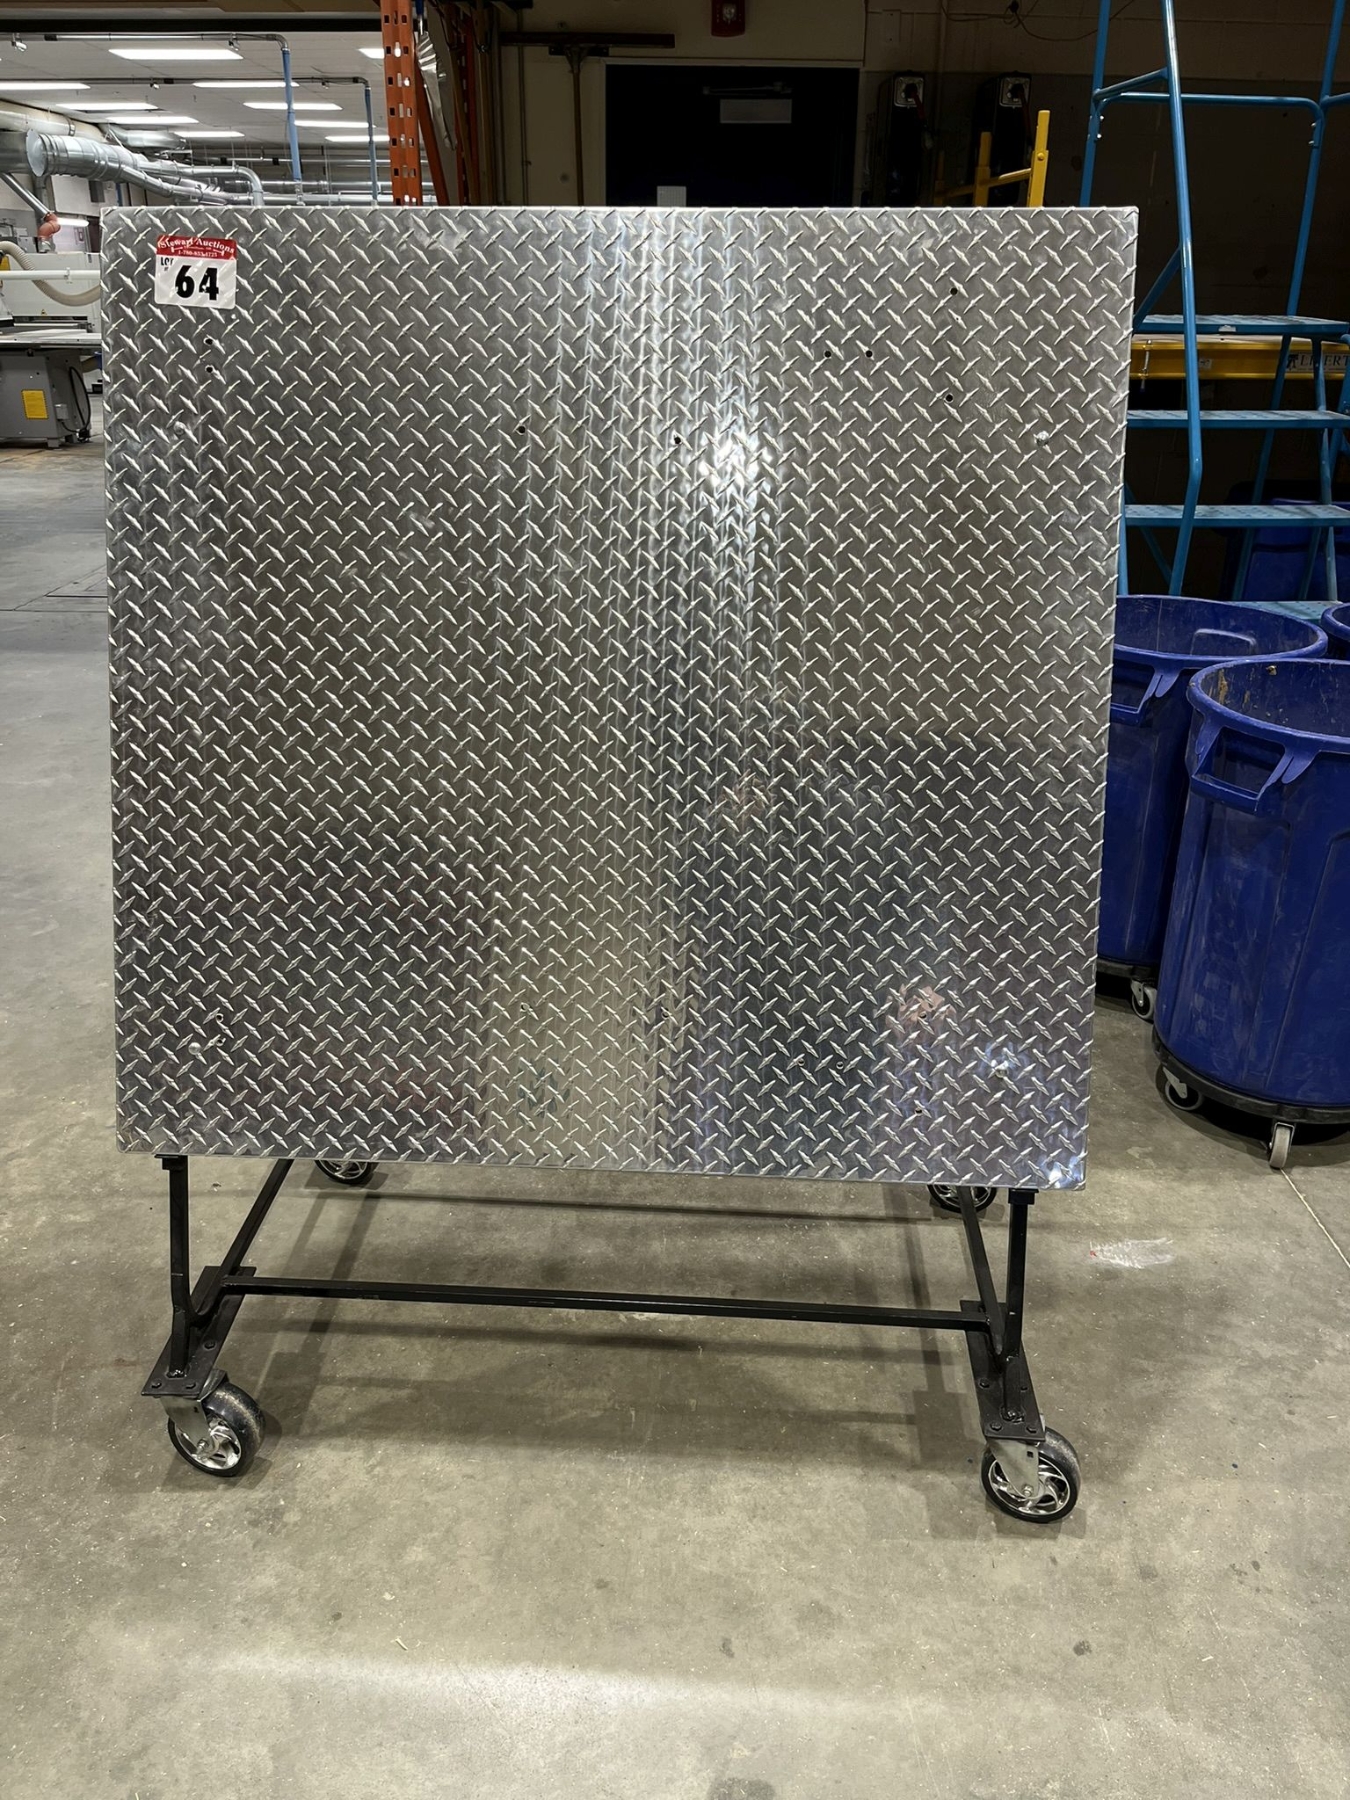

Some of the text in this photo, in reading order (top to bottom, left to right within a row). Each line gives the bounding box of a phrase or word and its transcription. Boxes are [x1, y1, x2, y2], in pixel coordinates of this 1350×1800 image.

[159, 237, 194, 249] Stewart
[196, 238, 235, 254] Auctions
[175, 265, 219, 300] 64
